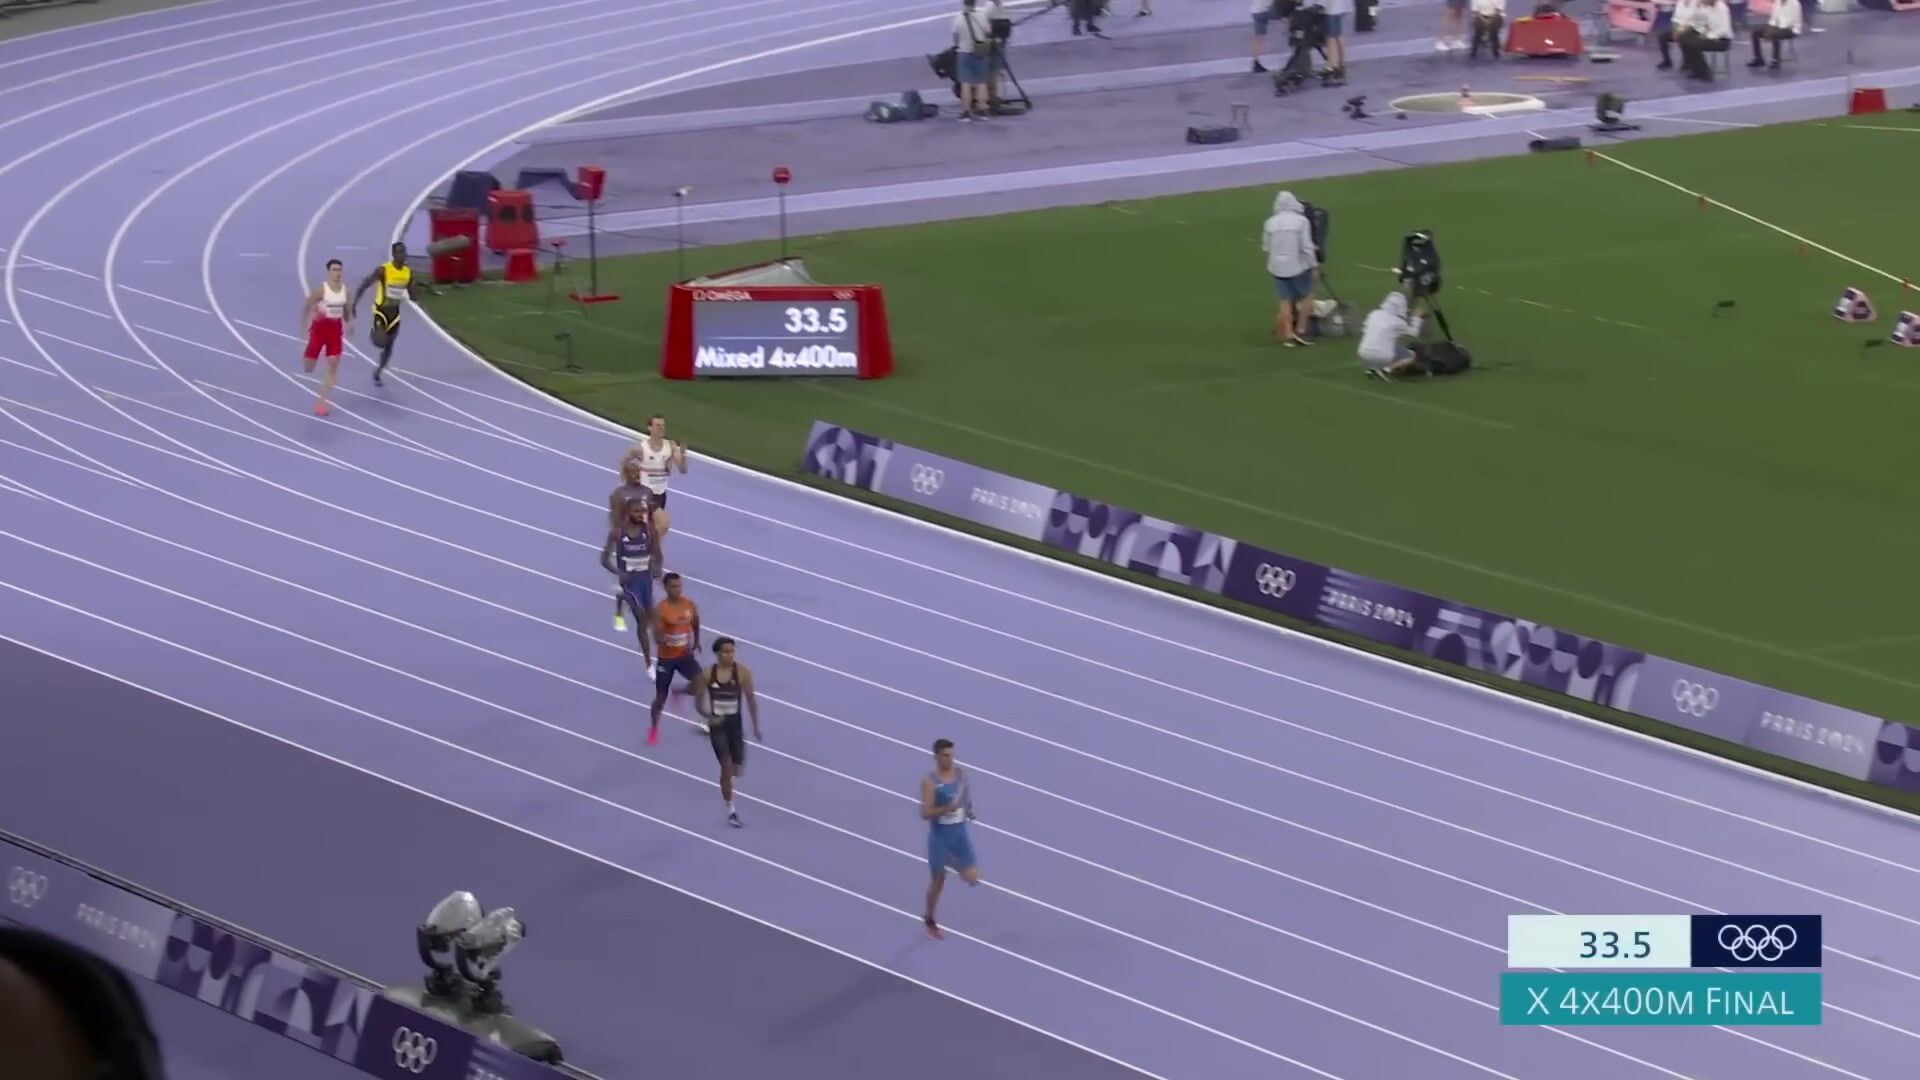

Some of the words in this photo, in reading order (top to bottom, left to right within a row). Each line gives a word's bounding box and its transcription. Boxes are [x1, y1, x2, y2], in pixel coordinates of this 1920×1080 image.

[784, 307, 848, 333] 33.5
[695, 345, 765, 368] Mixed
[768, 345, 858, 369] 4x400m
[970, 487, 1009, 511] PARIS
[1326, 589, 1373, 617] PARIS
[1372, 603, 1416, 629] 2024
[1760, 711, 1814, 741] PARIS
[1816, 727, 1864, 755] 2024
